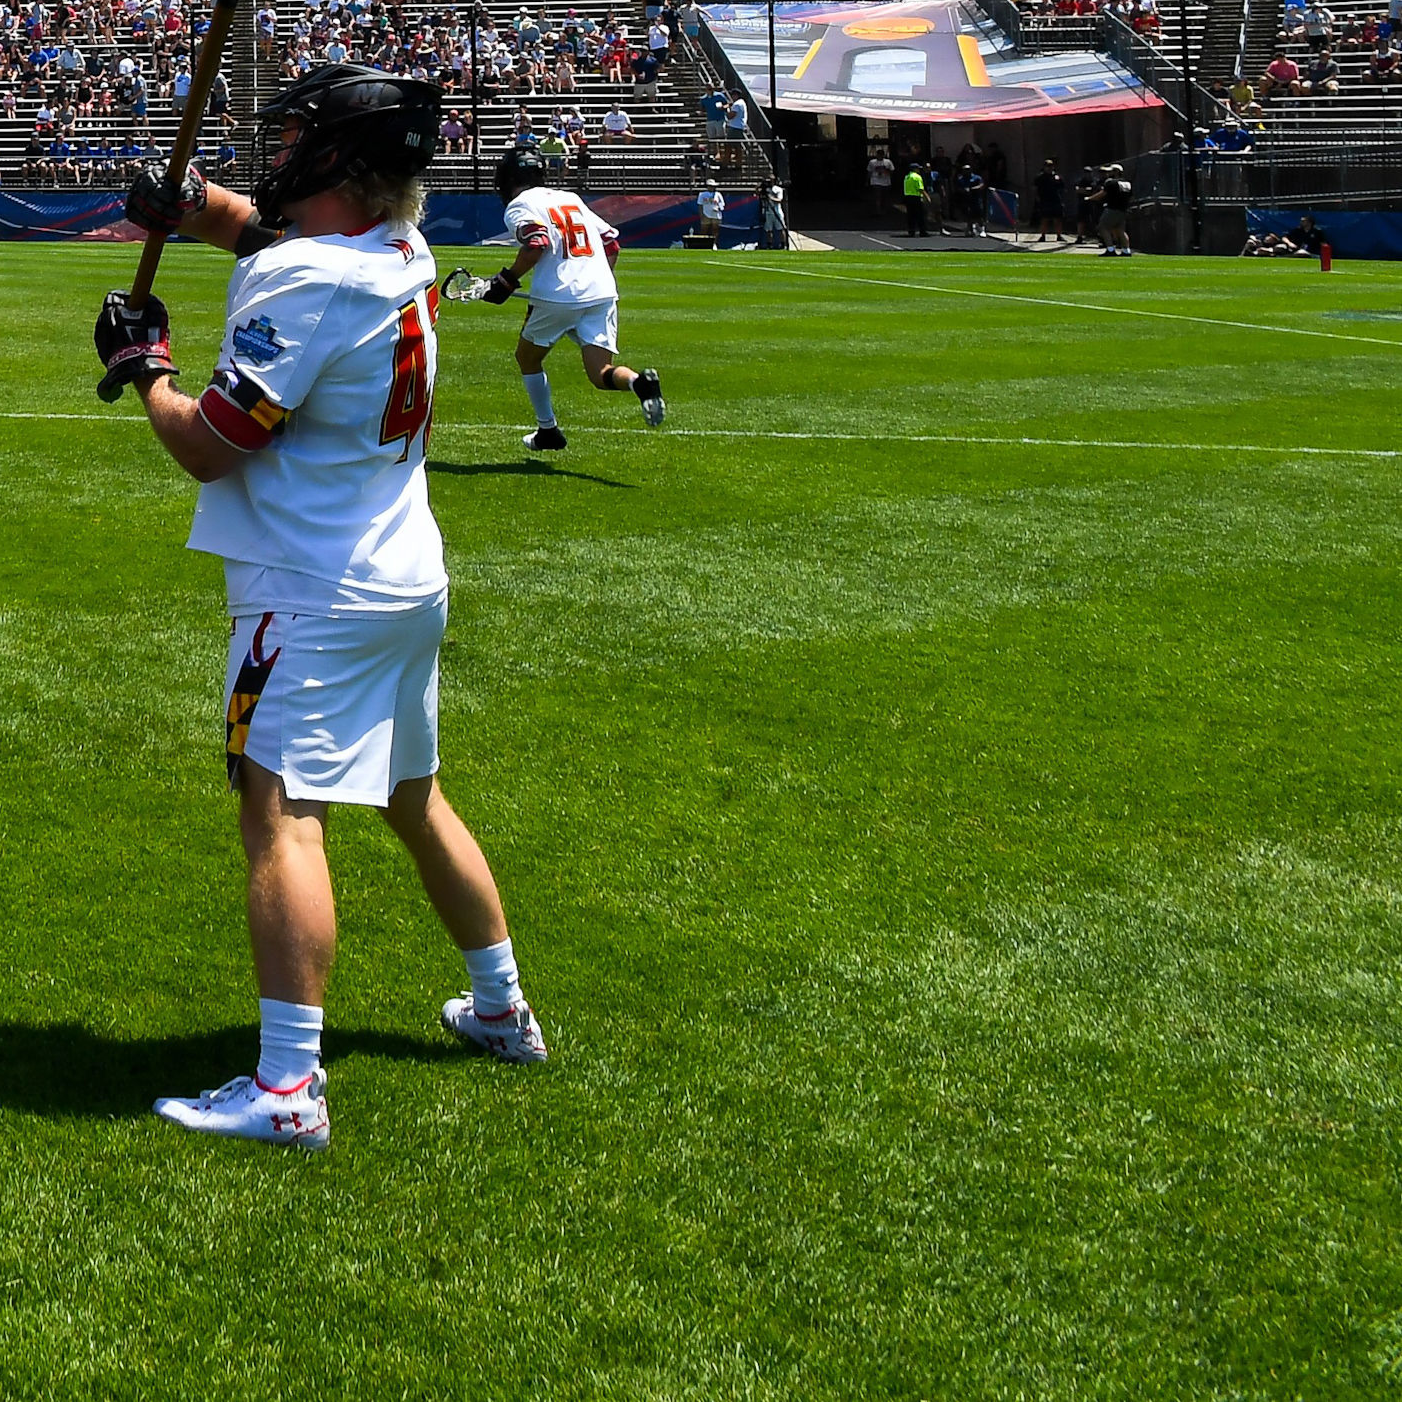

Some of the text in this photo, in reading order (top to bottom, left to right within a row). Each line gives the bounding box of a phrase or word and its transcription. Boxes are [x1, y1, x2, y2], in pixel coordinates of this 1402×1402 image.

[781, 91, 958, 110] NATIONAL CHAMPION
[405, 132, 421, 147] RM
[547, 205, 594, 259] 16
